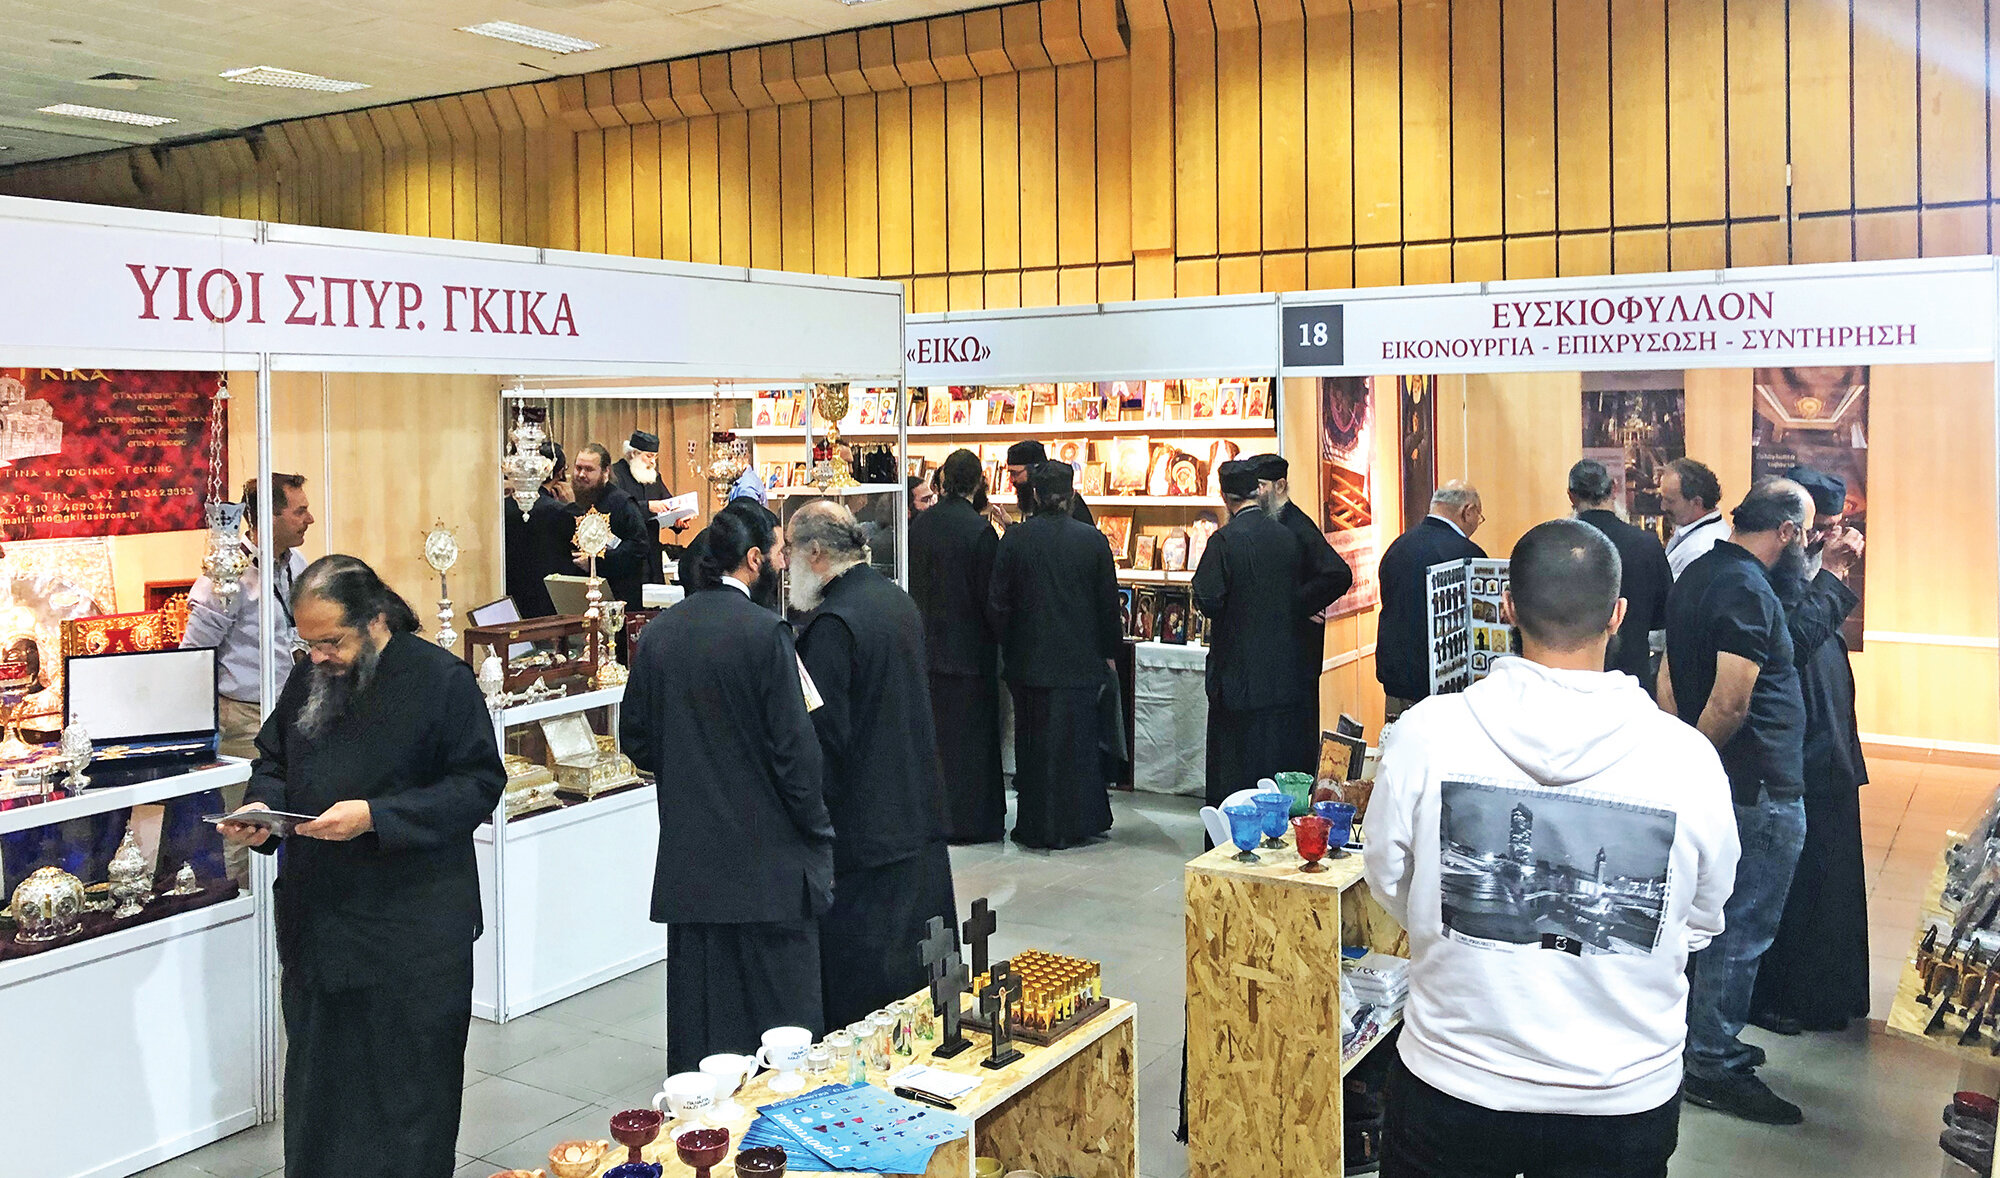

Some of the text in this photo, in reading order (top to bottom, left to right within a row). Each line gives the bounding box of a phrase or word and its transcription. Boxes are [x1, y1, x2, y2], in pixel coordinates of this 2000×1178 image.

[126, 263, 580, 336] ΥΙΟΙ ΣΠΥΡ. ΓΚΙΚΑ
[1492, 291, 1775, 330] ΕΥΣΚΙΟΦΥΛΛΟΝ
[906, 336, 991, 364] «ΕΙΚΩ»
[1299, 322, 1328, 347] 18
[1382, 336, 1535, 360] ΕΙΚΟΝΟΥΡΓΙΑ
[1557, 331, 1717, 356] ΕΠΙΧΡΥΣΩΣΗ
[1741, 324, 1917, 351] ΣΥΝΤΗΡΗΣΗ
